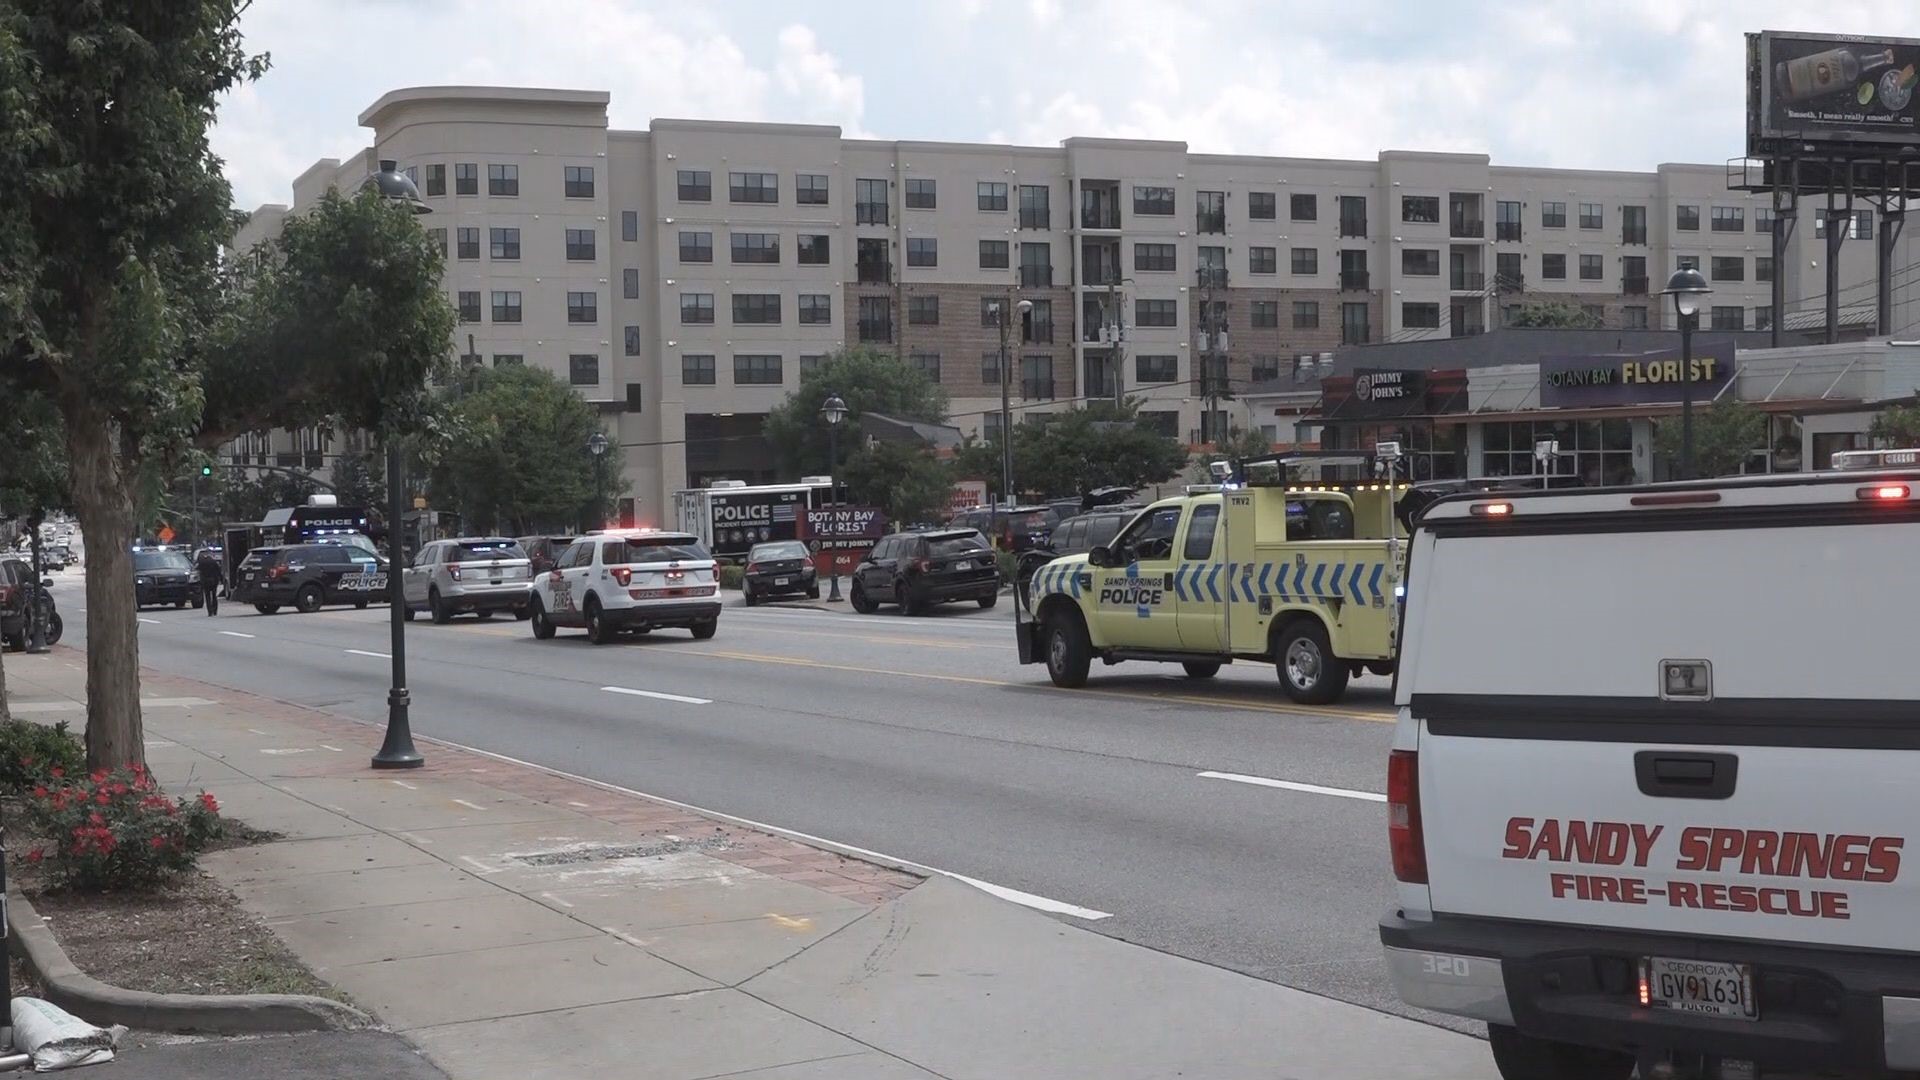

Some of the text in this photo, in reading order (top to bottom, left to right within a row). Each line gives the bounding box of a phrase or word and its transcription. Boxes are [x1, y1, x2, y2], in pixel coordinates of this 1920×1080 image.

[1371, 372, 1402, 387] JIMMY
[1547, 358, 1715, 387] BOTANY BAY FLORIST
[1371, 386, 1403, 402] JOHN'S
[713, 504, 770, 521] POLICE
[854, 511, 875, 521] BAY
[304, 519, 353, 527] POLICE
[835, 556, 851, 565] 064
[338, 579, 388, 590] POLICE
[1104, 577, 1163, 587] SANDY SPRINGS
[1100, 588, 1163, 605] POLICE
[1502, 817, 1904, 883] SANDY SPRINGS
[1550, 873, 1850, 919] FIRE-RESCUE
[1423, 954, 1469, 976] 320
[1667, 961, 1728, 977] GEORGIA
[1661, 973, 1745, 1006] GV9163
[1681, 1004, 1720, 1014] FULTON
